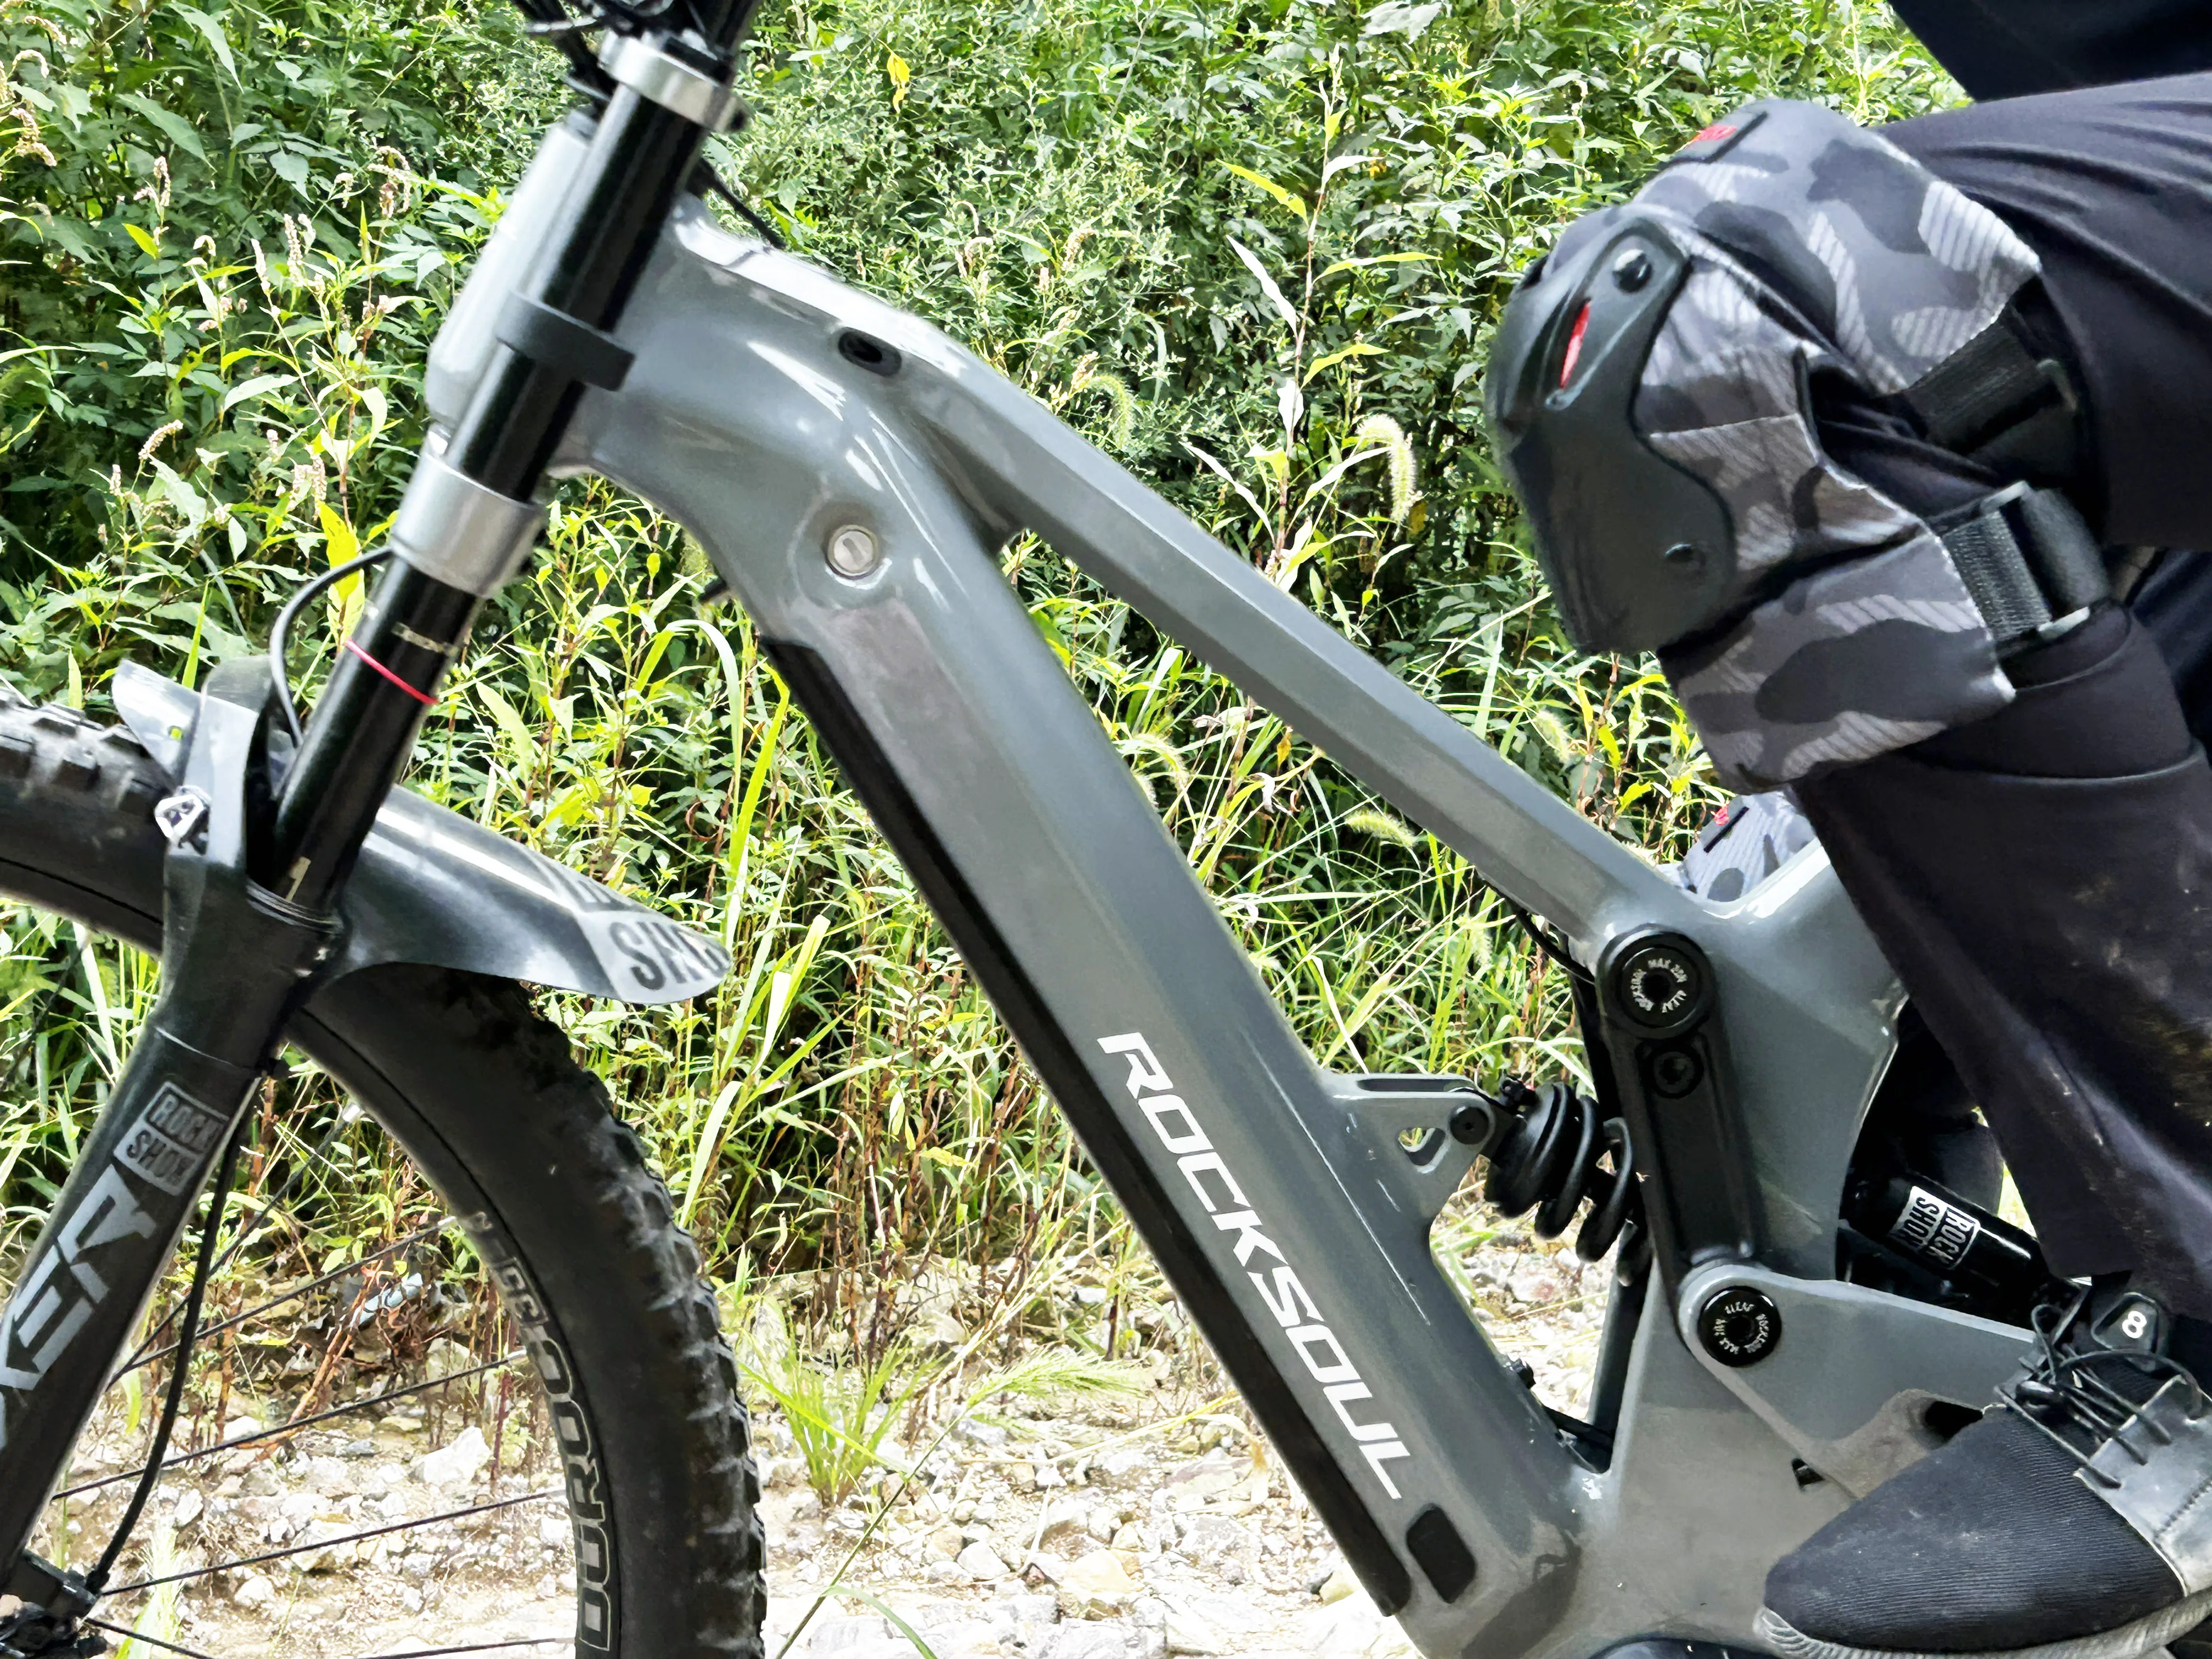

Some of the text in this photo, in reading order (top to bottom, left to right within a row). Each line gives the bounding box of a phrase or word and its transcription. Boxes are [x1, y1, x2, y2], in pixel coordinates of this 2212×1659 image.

[149, 1094, 223, 1151] ROCK
[1926, 1210, 1975, 1264] ROCK
[1097, 1032, 1410, 1499] ROCKSOUL
[2122, 1311, 2147, 1339] 8
